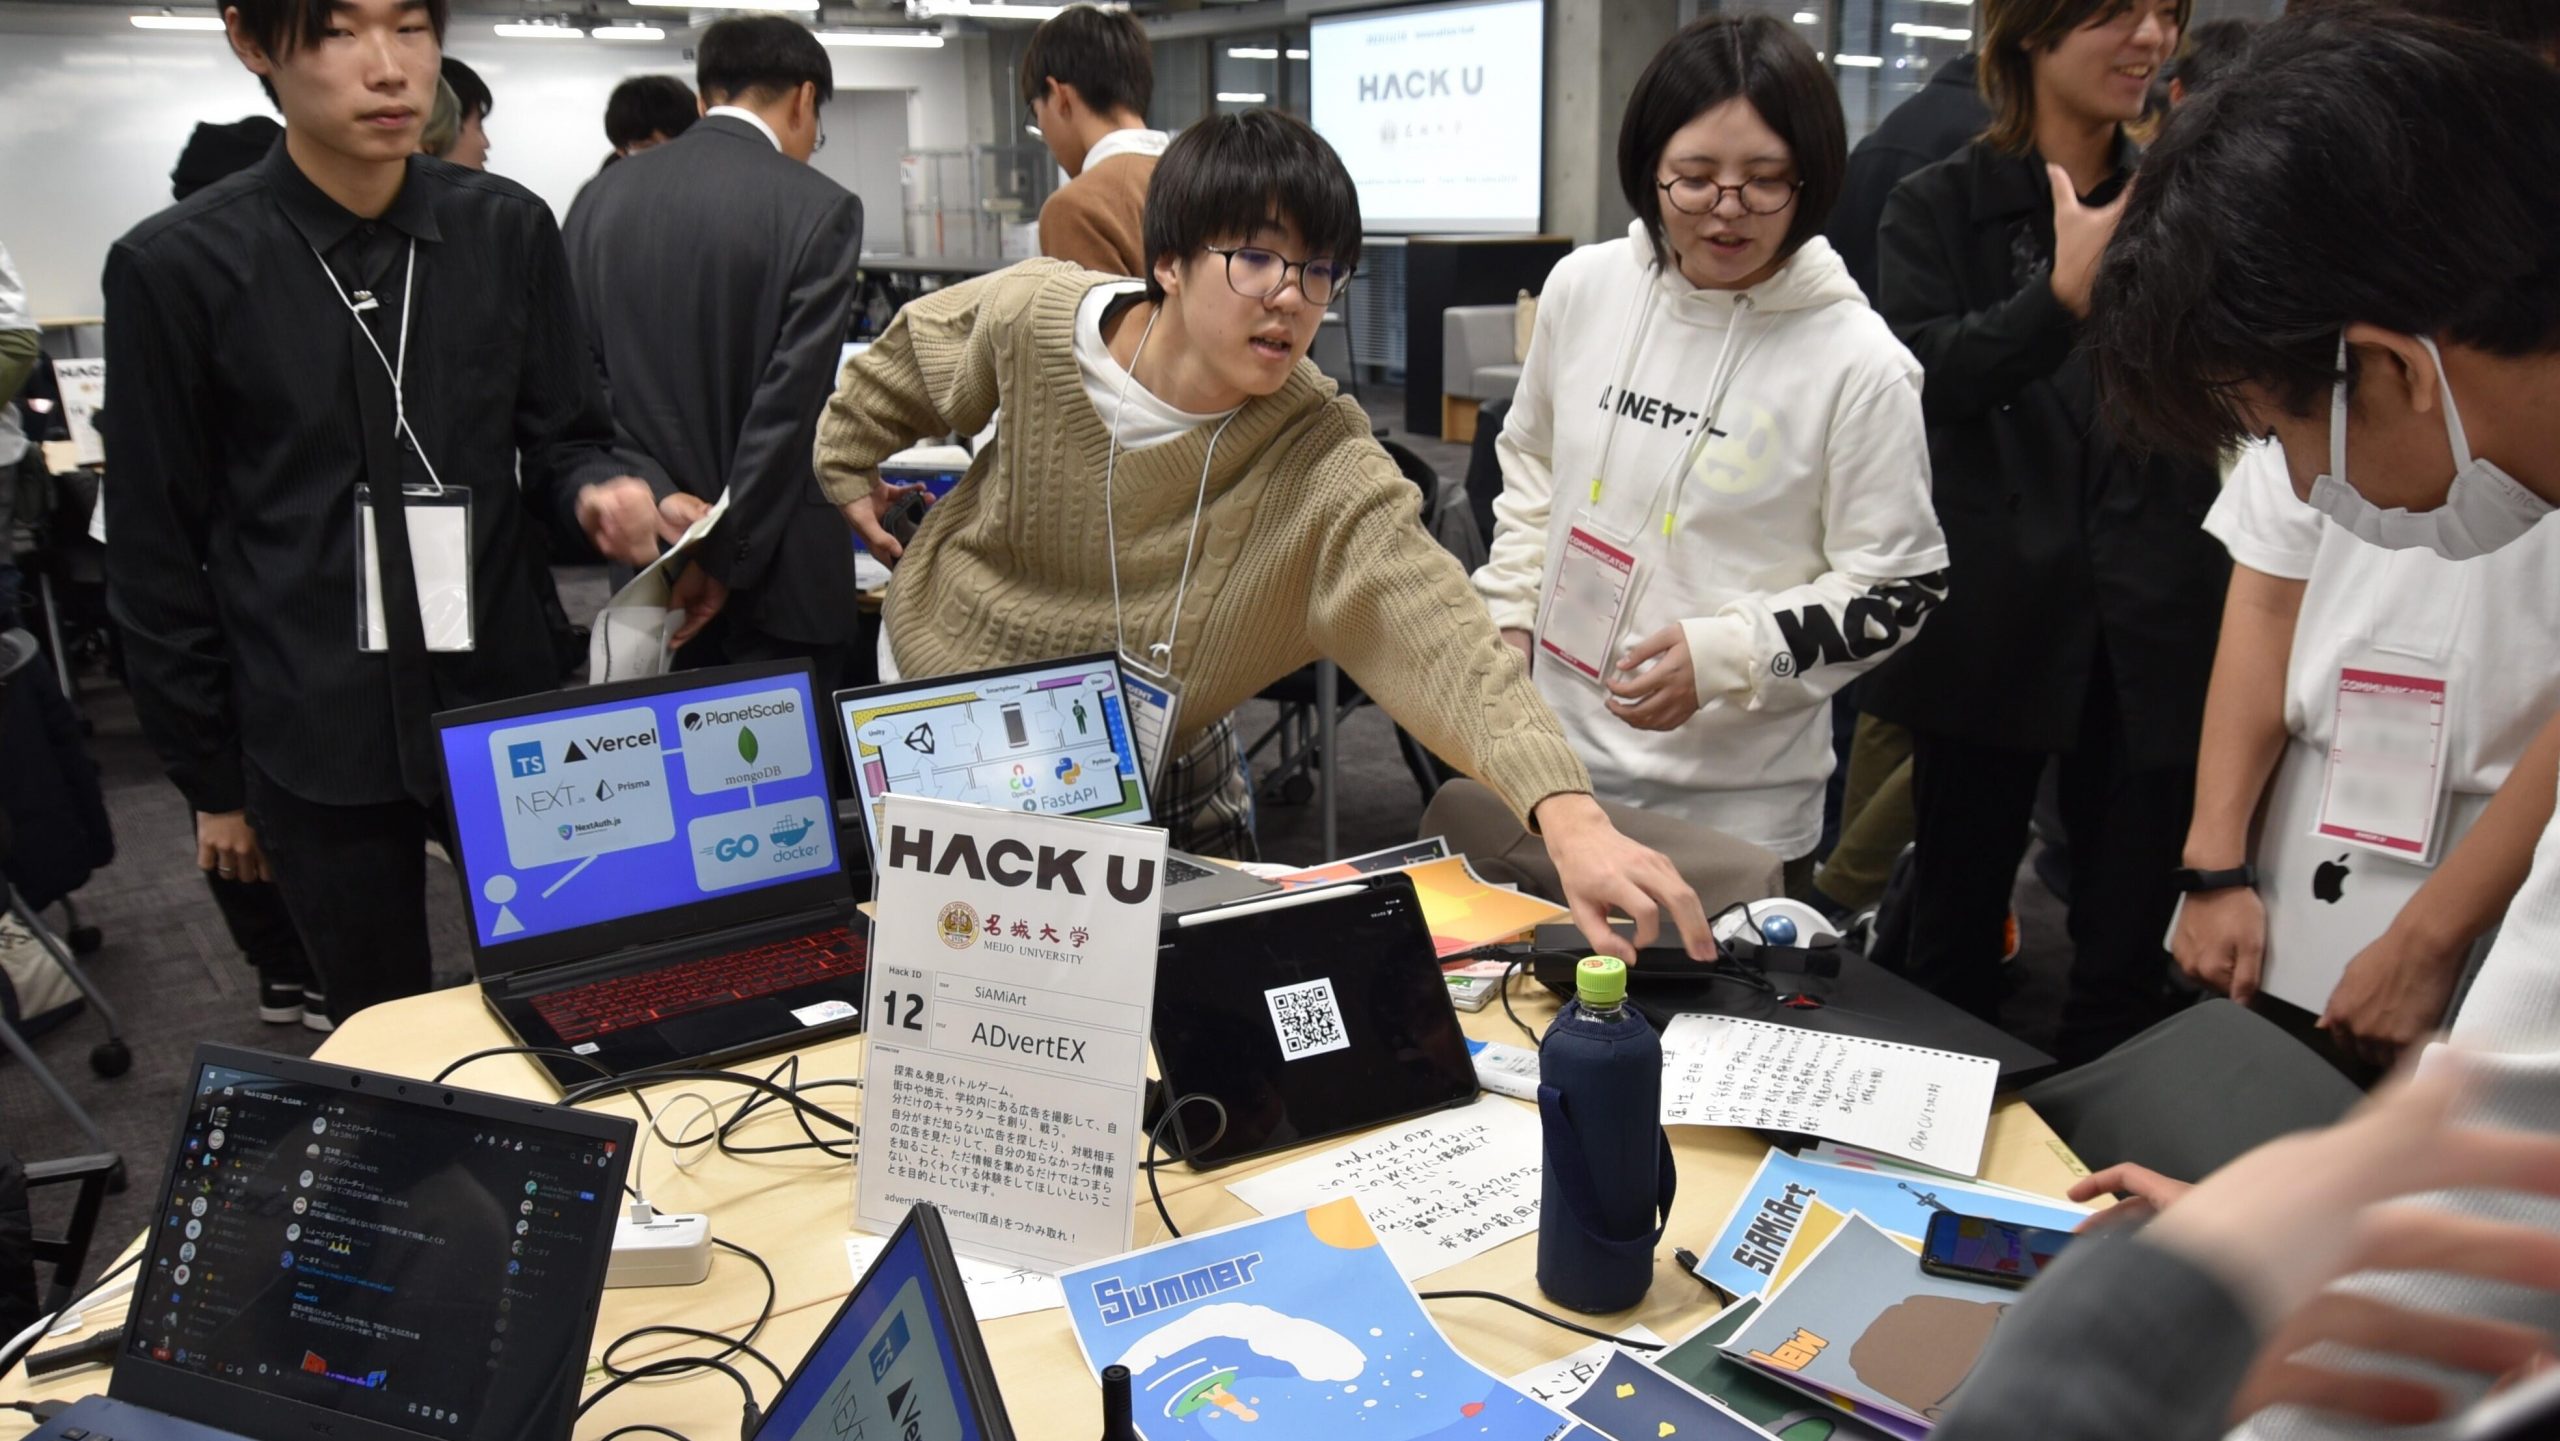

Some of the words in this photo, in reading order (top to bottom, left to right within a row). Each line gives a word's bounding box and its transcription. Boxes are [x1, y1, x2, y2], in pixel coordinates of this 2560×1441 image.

[1358, 68, 1451, 102] HACK
[1462, 66, 1484, 96] U
[1569, 534, 1631, 573] COMMUNICATOR
[705, 700, 795, 727] PlanetScale
[585, 728, 657, 754] Vercel
[517, 756, 543, 774] TS
[725, 765, 782, 786] mongoDB
[617, 780, 650, 792] Prisma
[1041, 786, 1098, 810] FastAPI
[575, 817, 621, 833] NextAuth.js
[773, 844, 820, 863] docker
[889, 825, 1087, 896] HACK
[1106, 854, 1155, 904] U
[983, 914, 1089, 948] 名城大学
[983, 940, 1014, 954] MEIJO
[1019, 946, 1084, 965] UNIVERSITY
[888, 966, 909, 977] Hack
[912, 969, 922, 979] ID
[974, 986, 1027, 1006] SiAMiArt
[883, 990, 924, 1031] 12
[971, 1022, 1086, 1063] ADvertEX
[1334, 1139, 1401, 1168] android
[887, 1164, 996, 1198] とを目的としています。
[1732, 1180, 1819, 1278] SiAMiArt
[1091, 1252, 1262, 1326] Summer
[873, 1337, 895, 1378] TS
